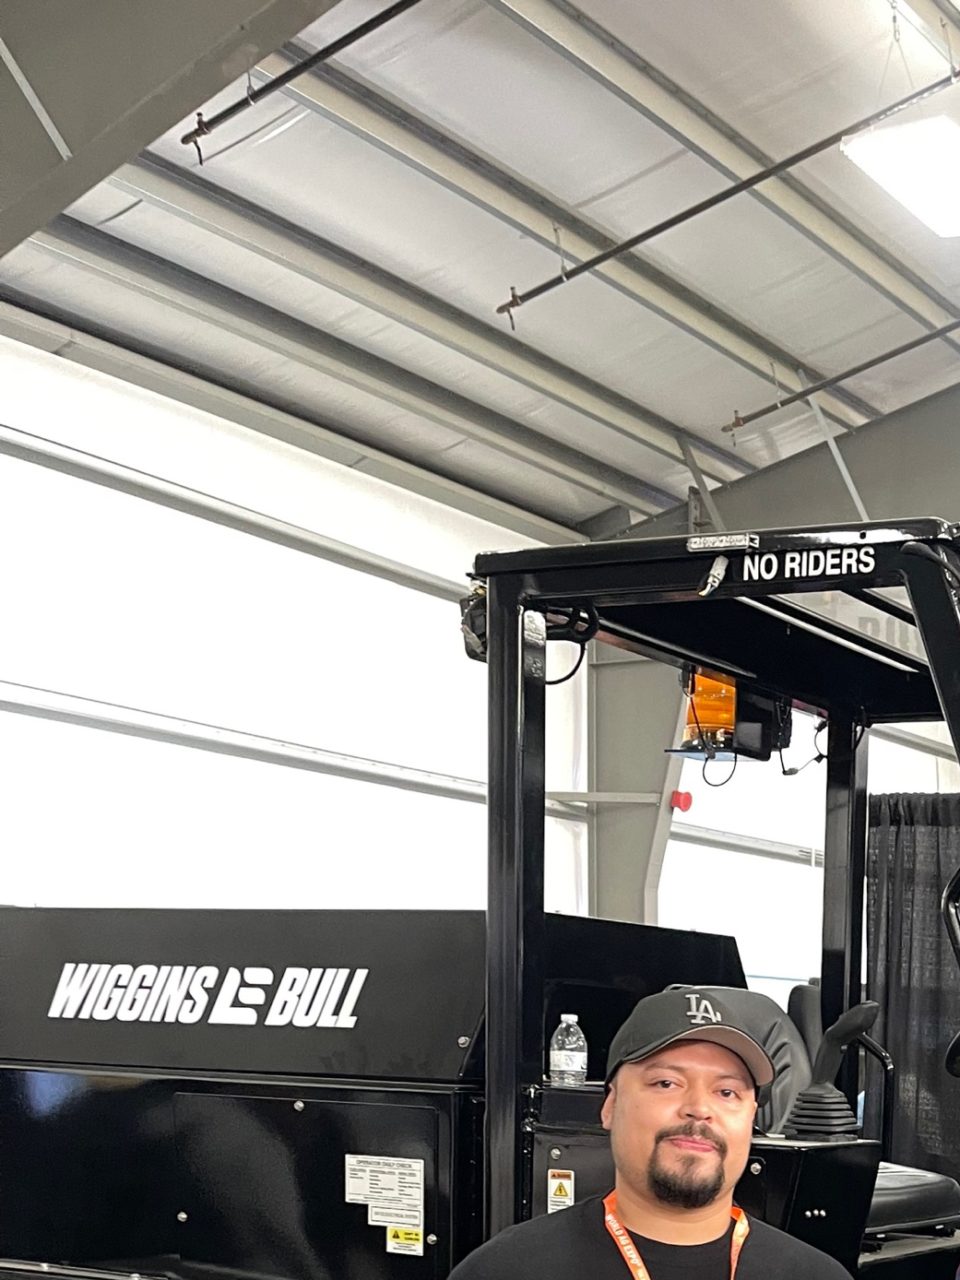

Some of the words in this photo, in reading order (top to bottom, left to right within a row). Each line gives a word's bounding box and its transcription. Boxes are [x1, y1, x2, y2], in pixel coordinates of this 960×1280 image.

[743, 553, 779, 581] NO
[785, 546, 876, 579] RIDERS
[48, 963, 219, 1025] WIGGINS
[685, 994, 721, 1024] LA
